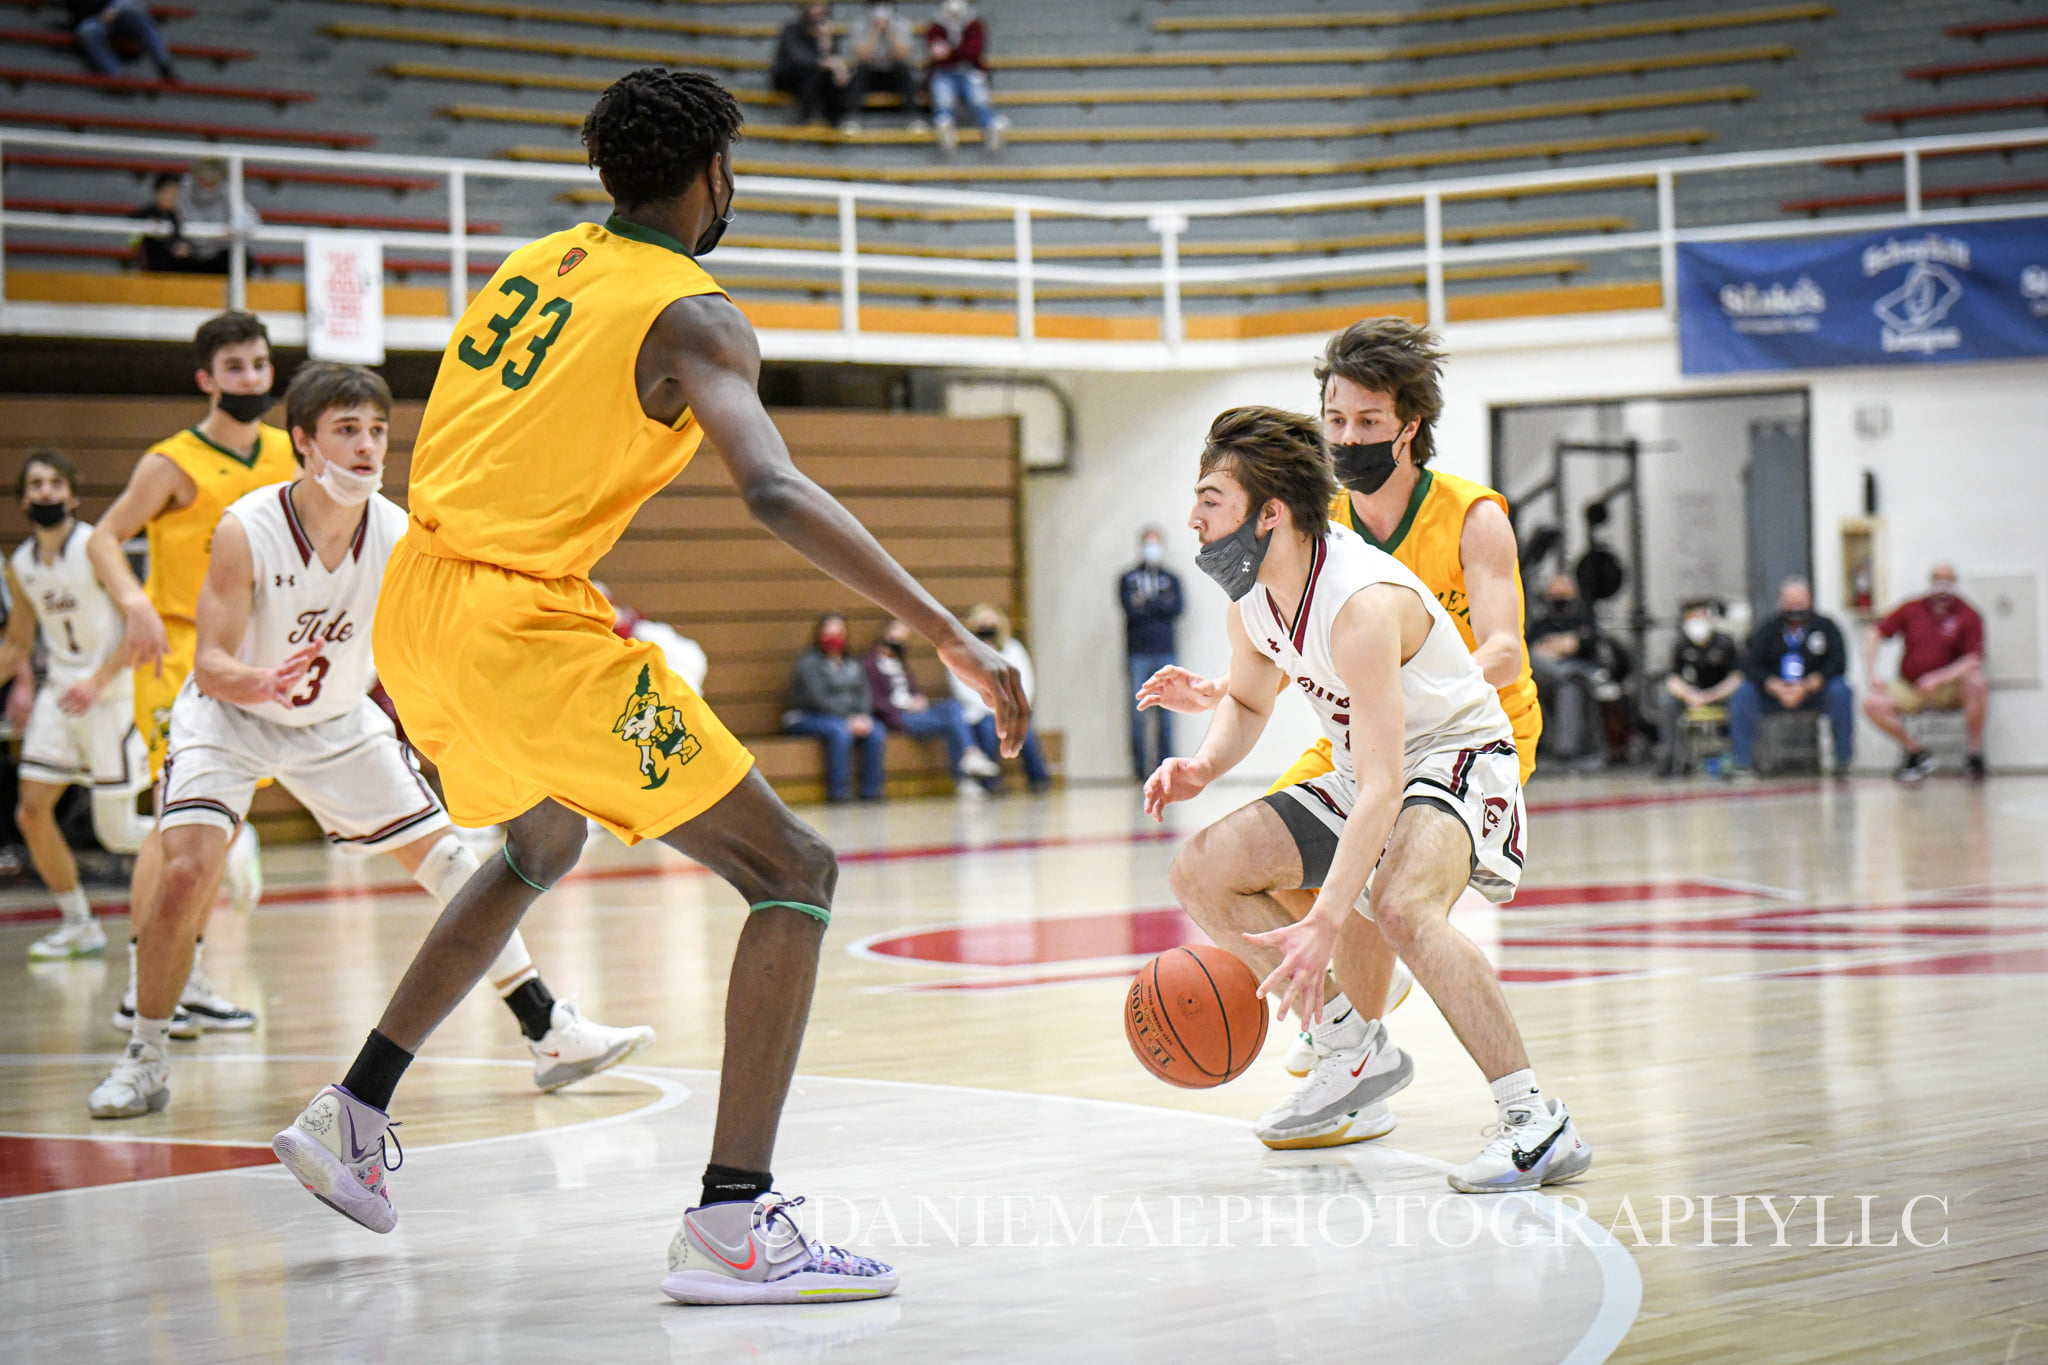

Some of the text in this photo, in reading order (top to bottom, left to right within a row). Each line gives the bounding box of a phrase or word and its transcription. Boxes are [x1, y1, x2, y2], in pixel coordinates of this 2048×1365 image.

[458, 275, 573, 391] 33
[288, 608, 354, 644] Tide
[291, 656, 330, 707] 3
